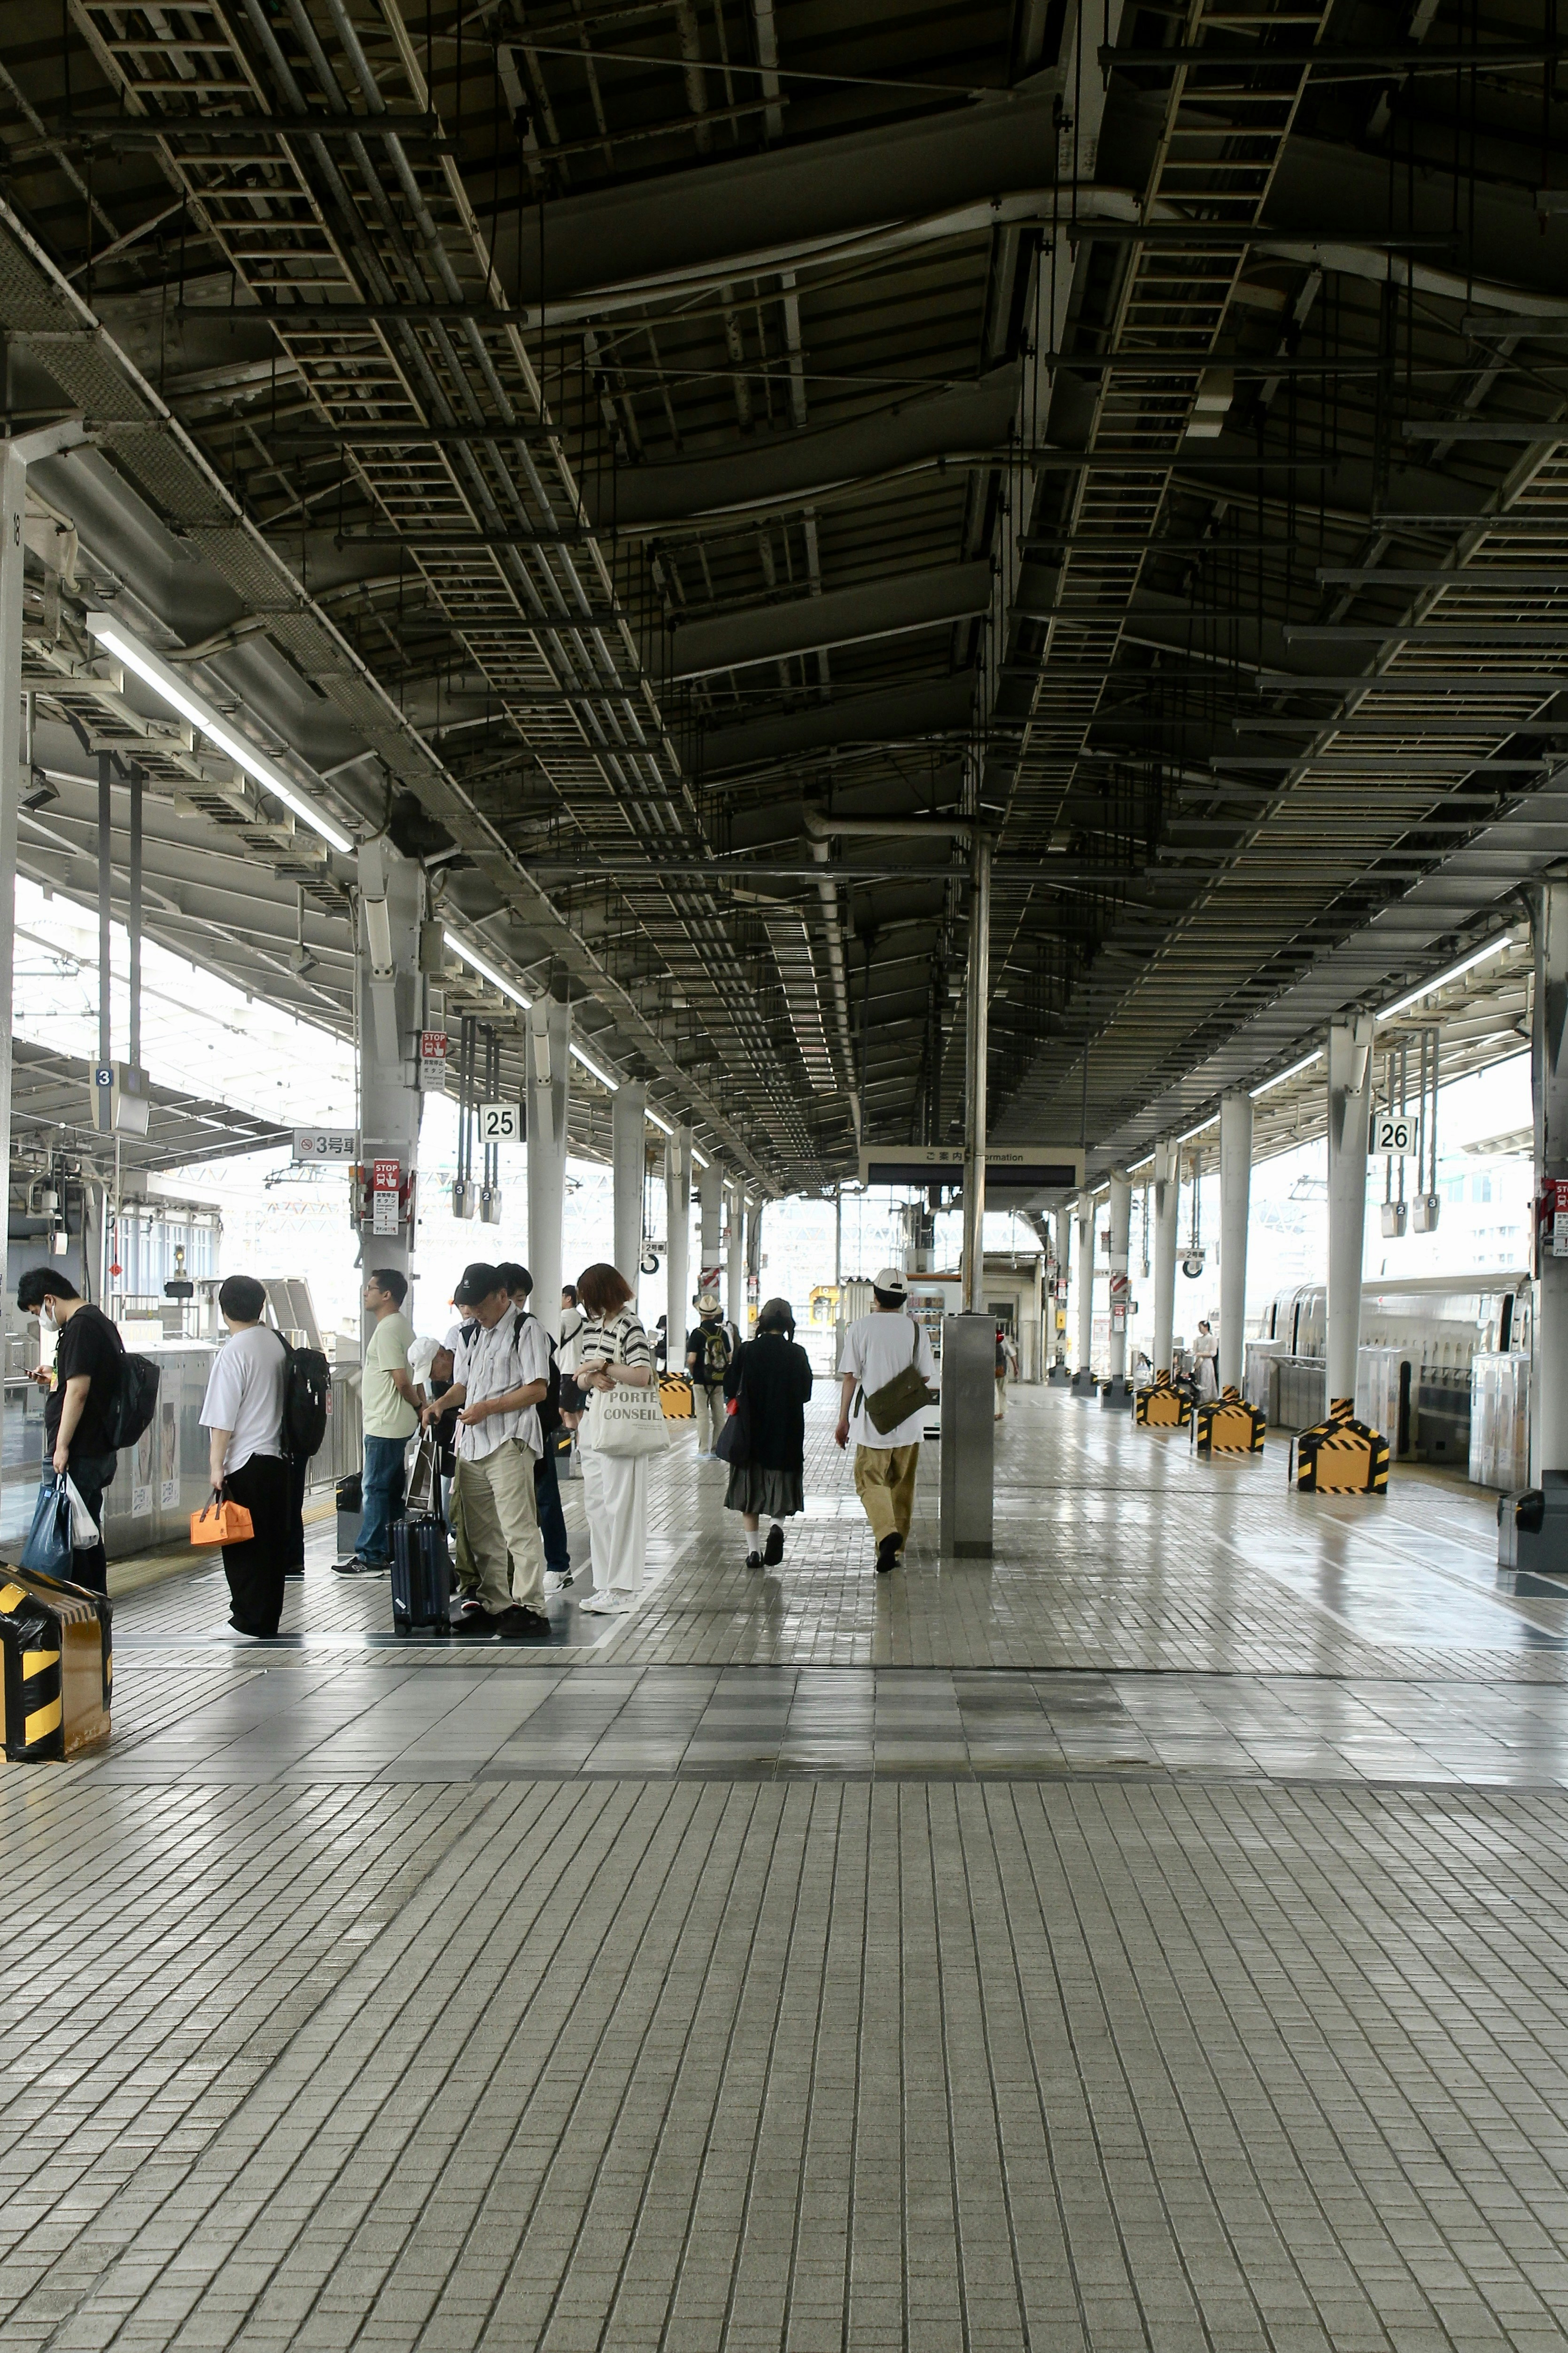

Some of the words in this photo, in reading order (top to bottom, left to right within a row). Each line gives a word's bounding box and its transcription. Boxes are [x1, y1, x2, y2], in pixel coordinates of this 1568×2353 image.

[14, 512, 20, 546] 18
[99, 1070, 110, 1085] 3
[487, 1112, 513, 1135] 25
[1381, 1124, 1407, 1147] 26
[316, 1136, 355, 1154] 3号車
[926, 1152, 962, 1161] ご案内
[456, 1185, 463, 1194] 3
[610, 1392, 658, 1403] PORTE
